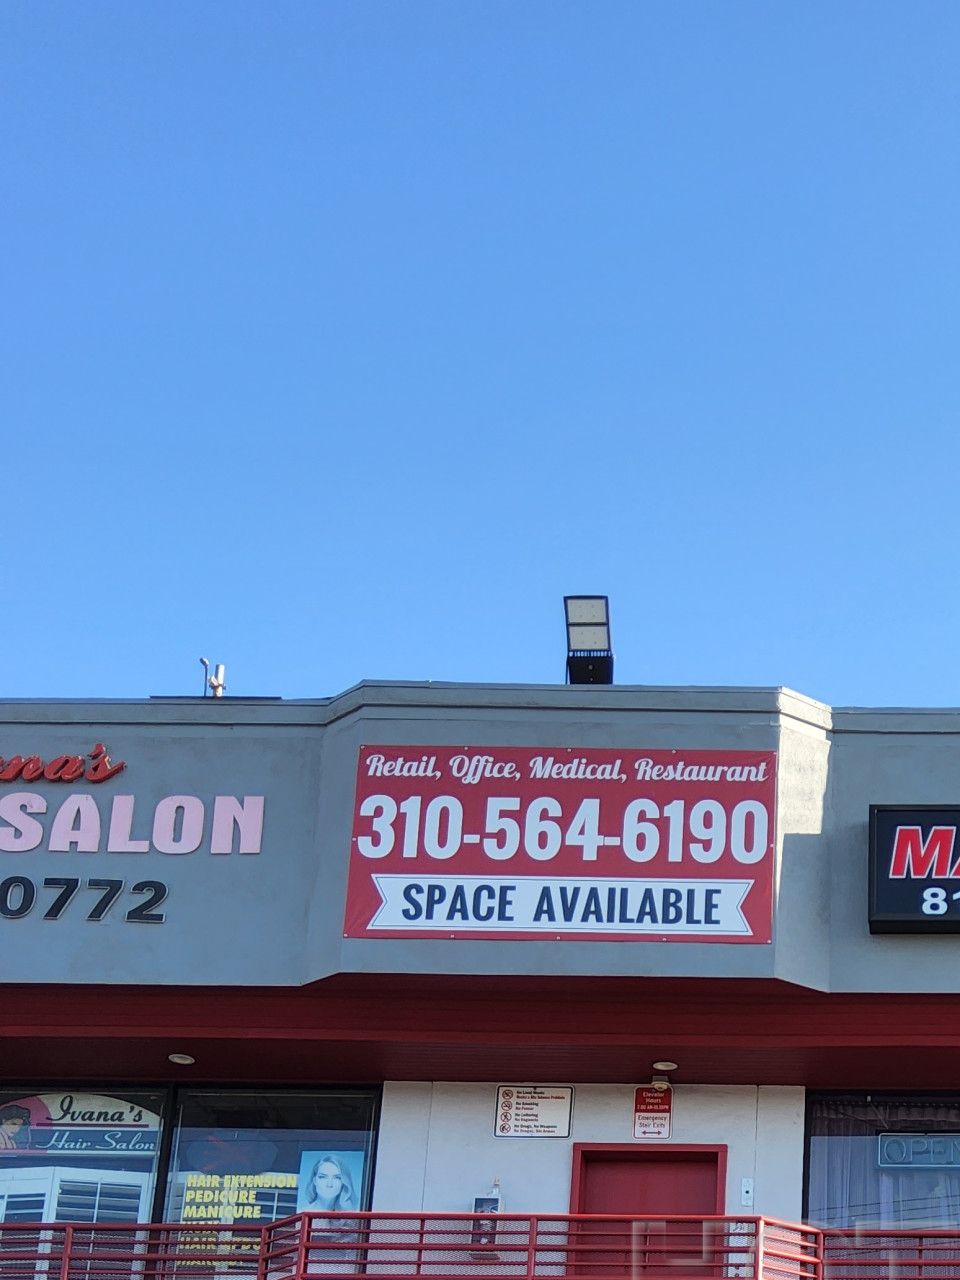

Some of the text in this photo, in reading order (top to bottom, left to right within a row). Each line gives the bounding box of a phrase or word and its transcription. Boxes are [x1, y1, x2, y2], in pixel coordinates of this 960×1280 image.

[366, 754, 769, 784] Retail, Office, Medical, Restaurant
[0, 792, 265, 854] SALON
[357, 794, 769, 864] 310-564-6190
[0, 876, 169, 924] 0772
[402, 883, 722, 925] SPACE AVAILABLE
[46, 1094, 143, 1123] Ivana's
[35, 1131, 156, 1150] Hair Salon
[187, 1175, 297, 1188] HAIR EXTENSION
[185, 1190, 257, 1203] PEDICURE
[183, 1205, 262, 1218] MANICURE
